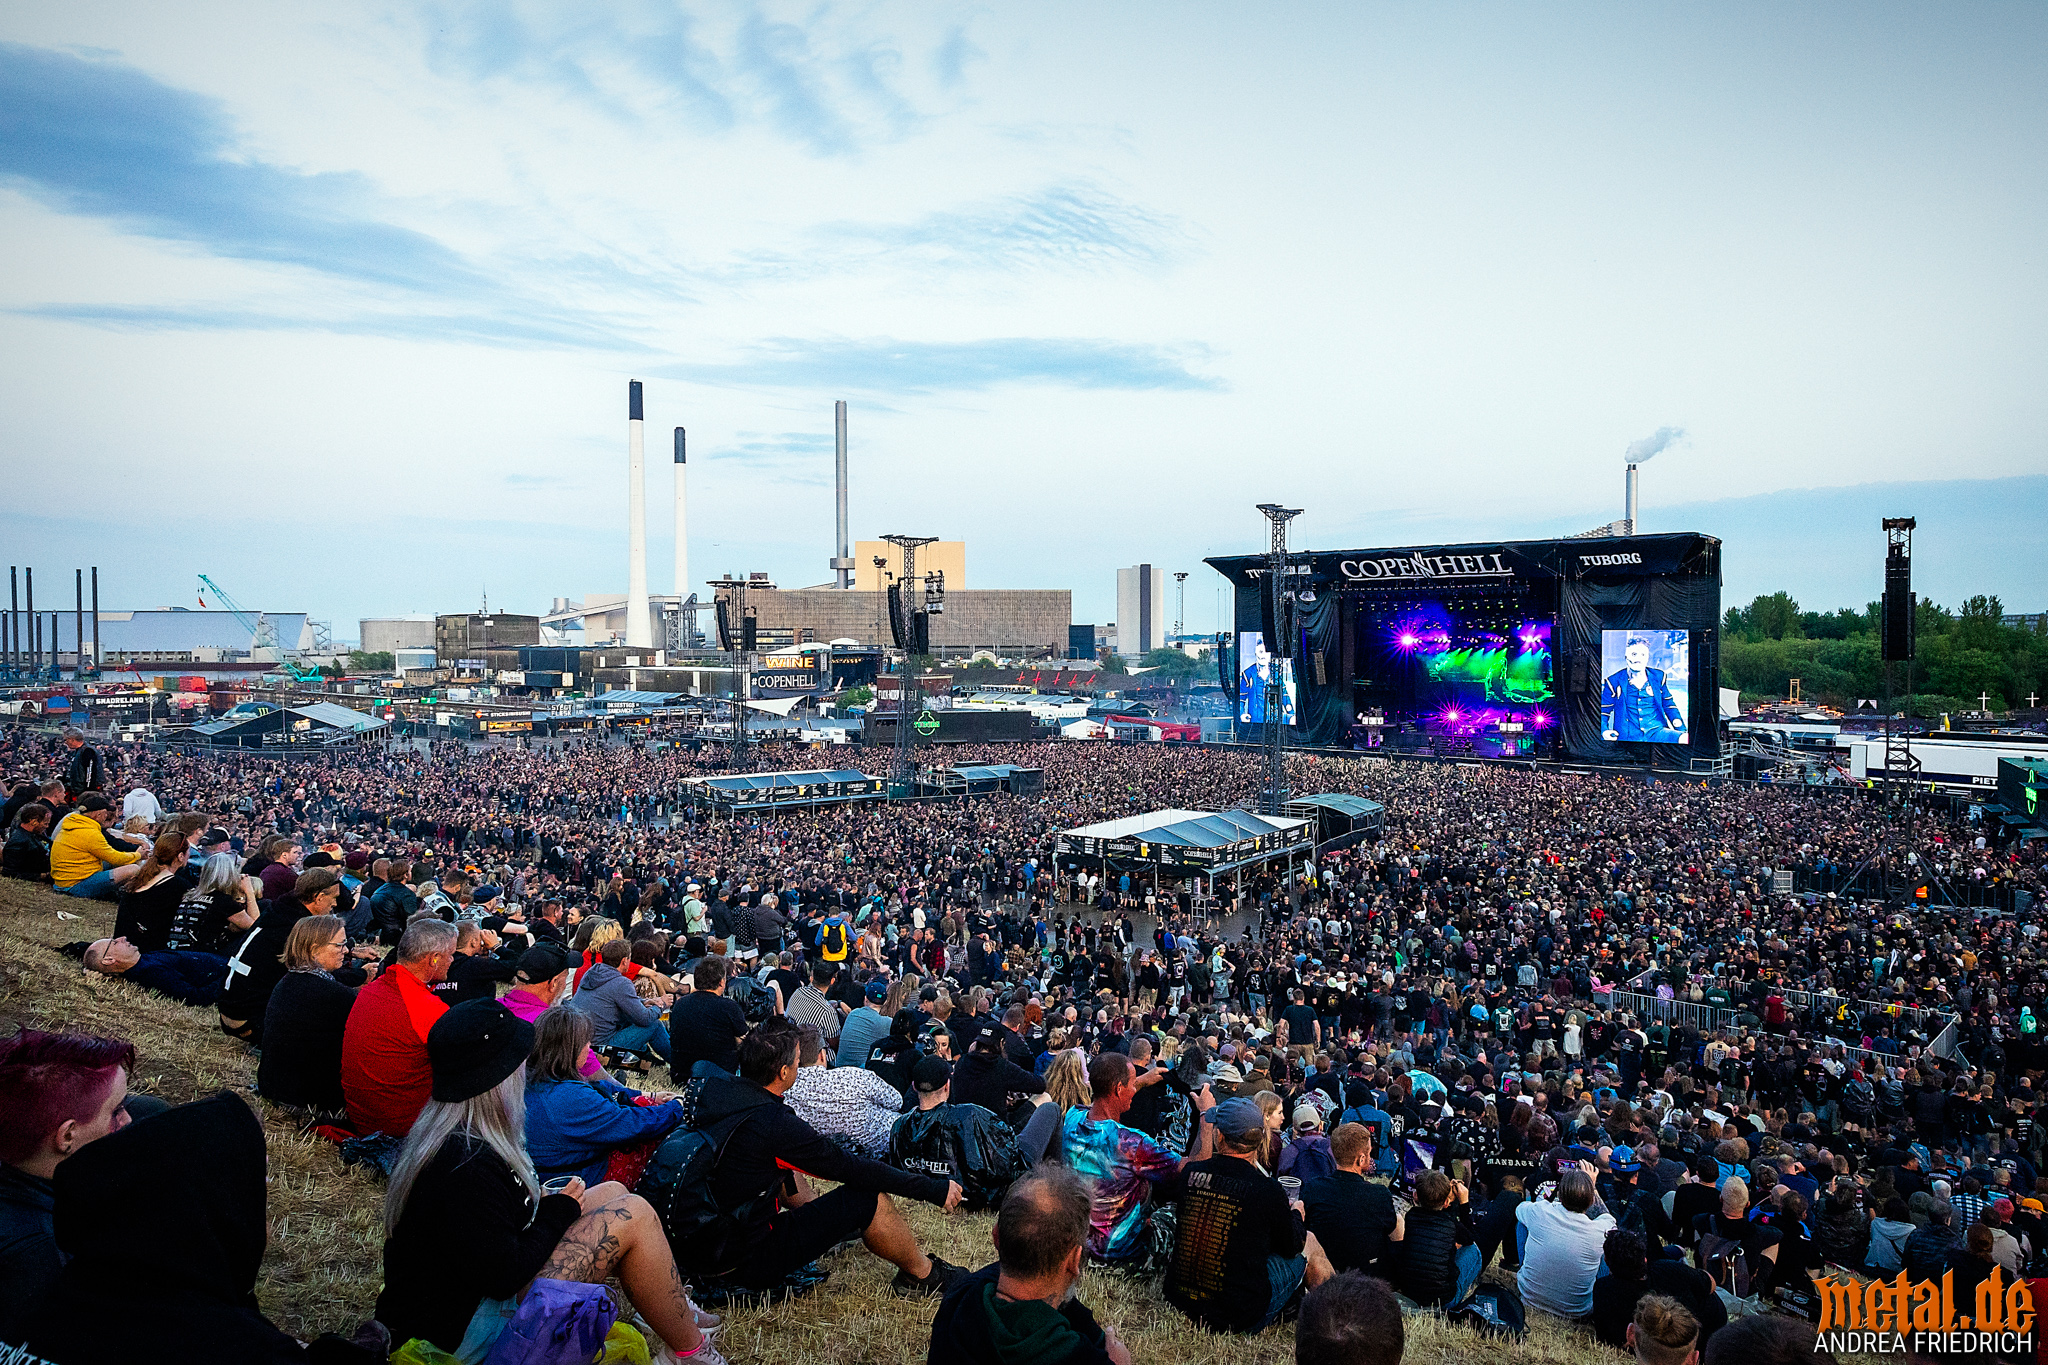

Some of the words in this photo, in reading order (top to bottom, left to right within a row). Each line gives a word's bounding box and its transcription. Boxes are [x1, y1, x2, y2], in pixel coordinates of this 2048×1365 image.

[1579, 552, 1642, 566] TUBORG
[1340, 551, 1514, 582] COPENHELL
[765, 656, 815, 669] WINE
[751, 674, 817, 689] #COPENHELL
